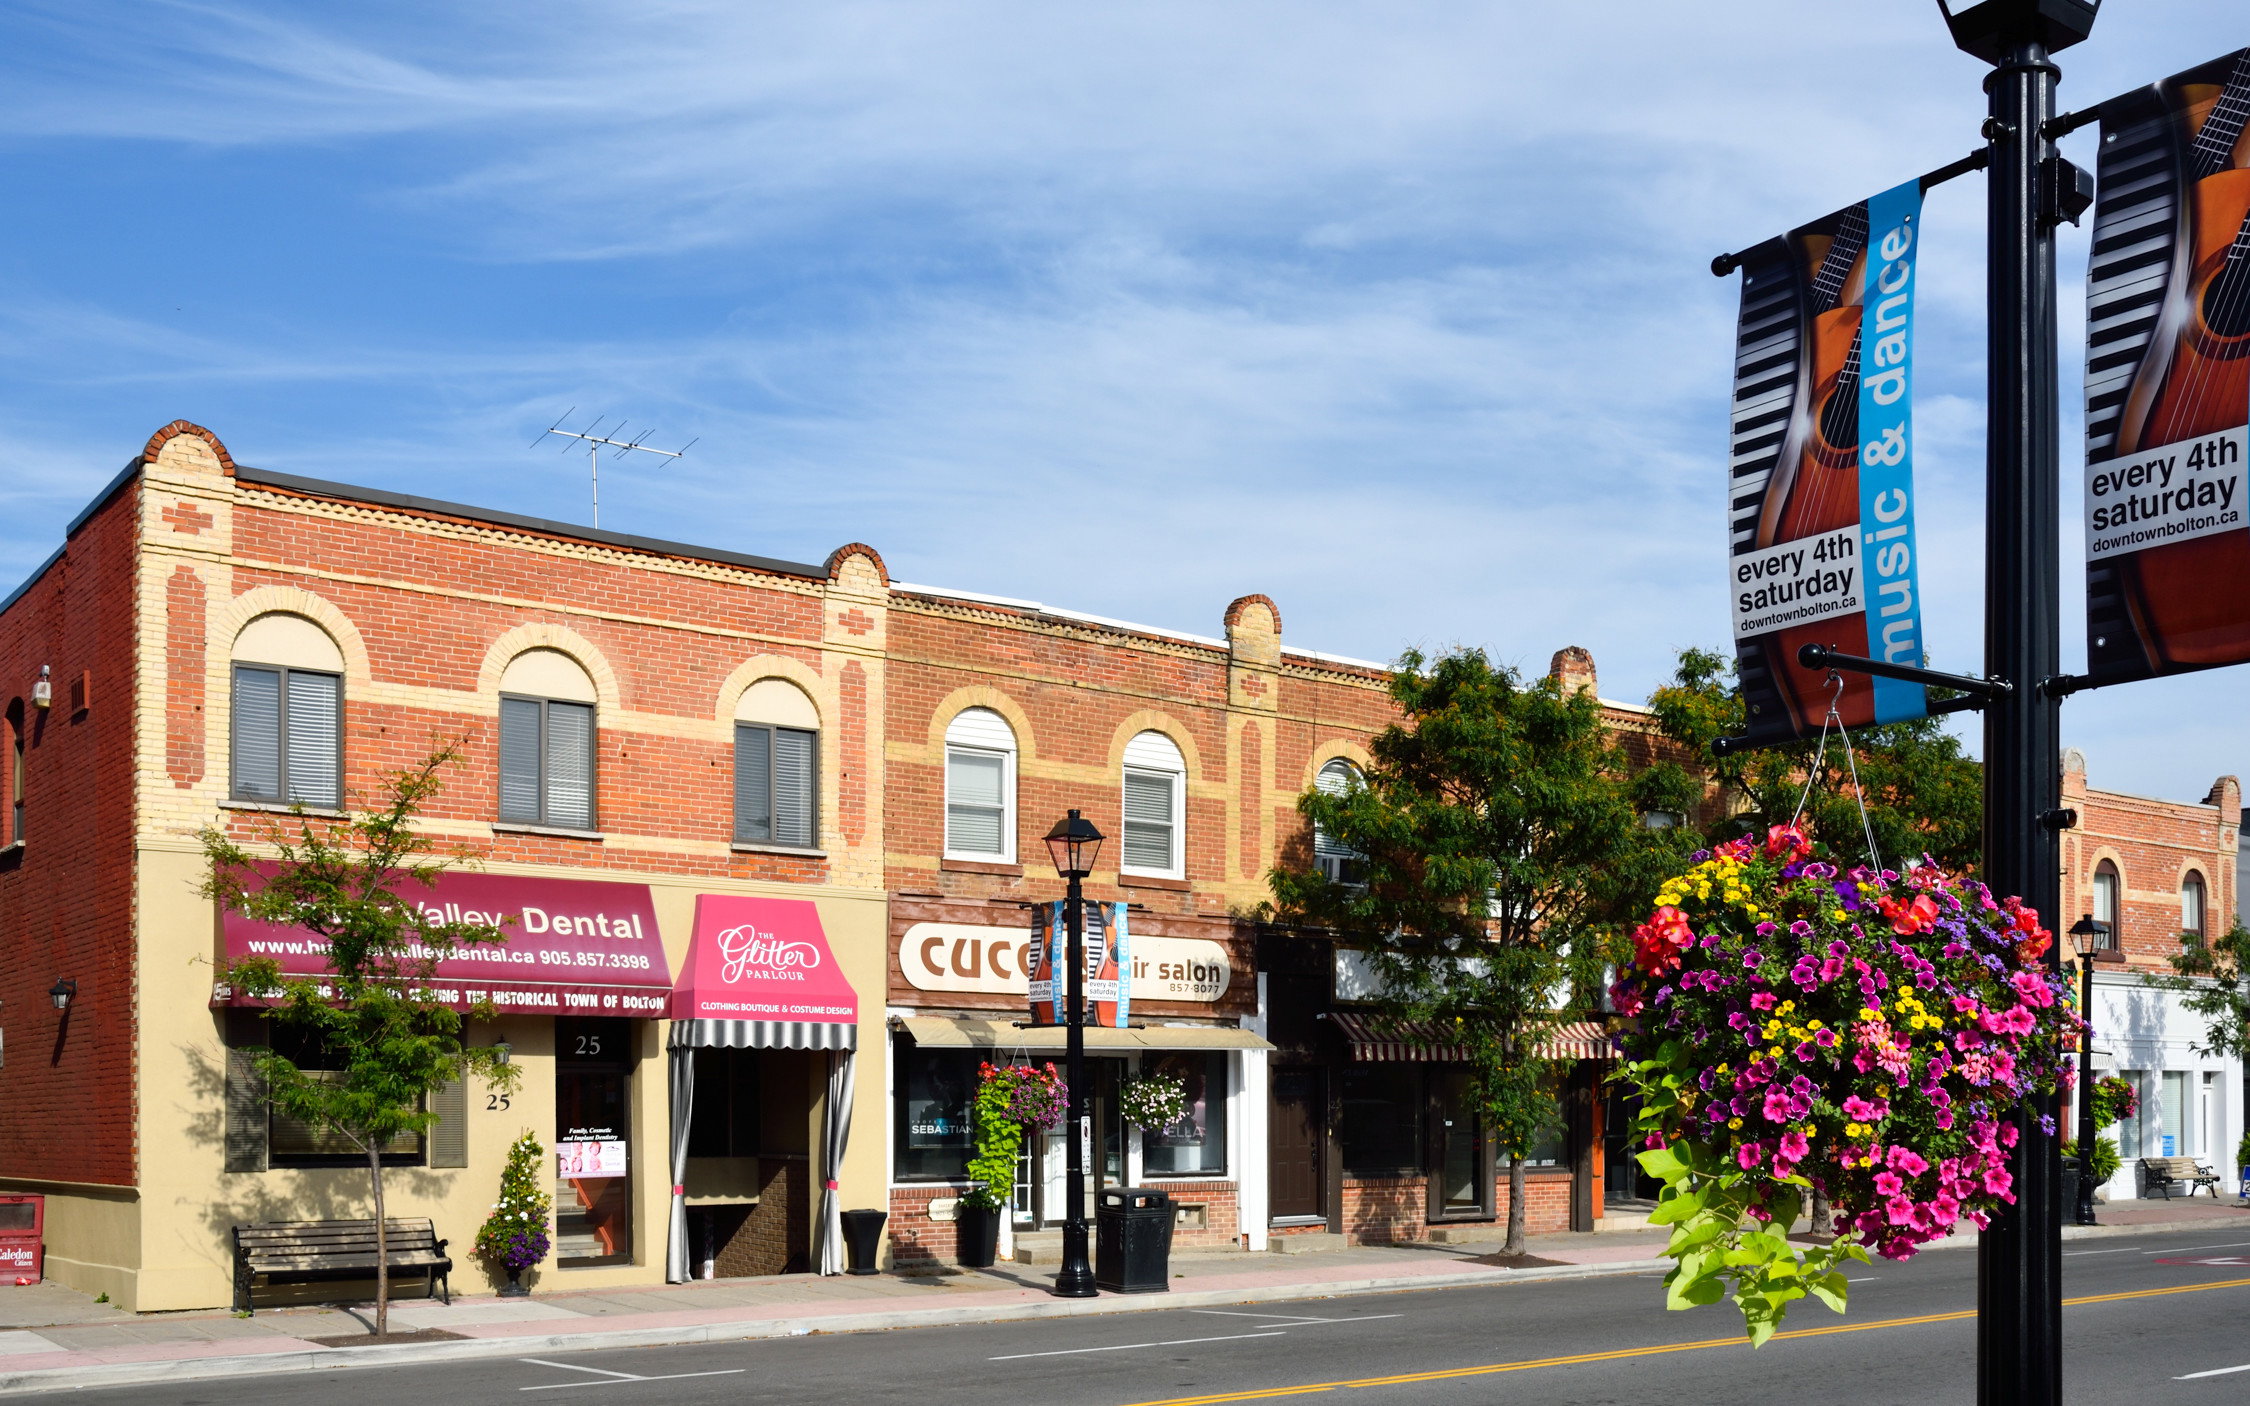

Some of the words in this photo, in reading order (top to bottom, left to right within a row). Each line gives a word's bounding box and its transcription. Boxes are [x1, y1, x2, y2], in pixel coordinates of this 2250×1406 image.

[1863, 422, 1906, 467] &
[2092, 456, 2176, 497] every
[2186, 436, 2238, 471] 4th
[2092, 476, 2237, 531] saturday
[2092, 510, 2239, 552] downtownbolton.ca
[1737, 549, 1805, 583] every
[1813, 533, 1854, 563] 4th
[1866, 487, 1917, 668] music
[1739, 567, 1854, 613] saturday
[1740, 596, 1857, 631] downtownbolton.ca
[402, 901, 502, 936] Valley
[522, 907, 643, 939] Dental
[540, 950, 650, 970] 905.857.3398
[717, 924, 820, 984] Glitter
[746, 969, 805, 981] PARLOUR
[1158, 958, 1220, 983] salon
[1030, 989, 1051, 997] saturday
[1089, 981, 1106, 989] every
[1089, 988, 1117, 997] saturday
[1169, 983, 1219, 994] 857-8077
[465, 990, 487, 1004] THE
[492, 991, 558, 1006] HISTORICAL
[564, 993, 598, 1007] TOWN
[603, 994, 618, 1008] OF
[622, 995, 665, 1009] BOLTON
[701, 1001, 740, 1012] CLOTHING
[740, 1002, 779, 1013] BOUTIQUE
[781, 1005, 788, 1013] &
[790, 1005, 825, 1014] COSTUME
[826, 1006, 853, 1016] DESIGN
[575, 1036, 600, 1055] 25
[486, 1094, 510, 1112] 25
[912, 1125, 974, 1134] SEBASTIAN
